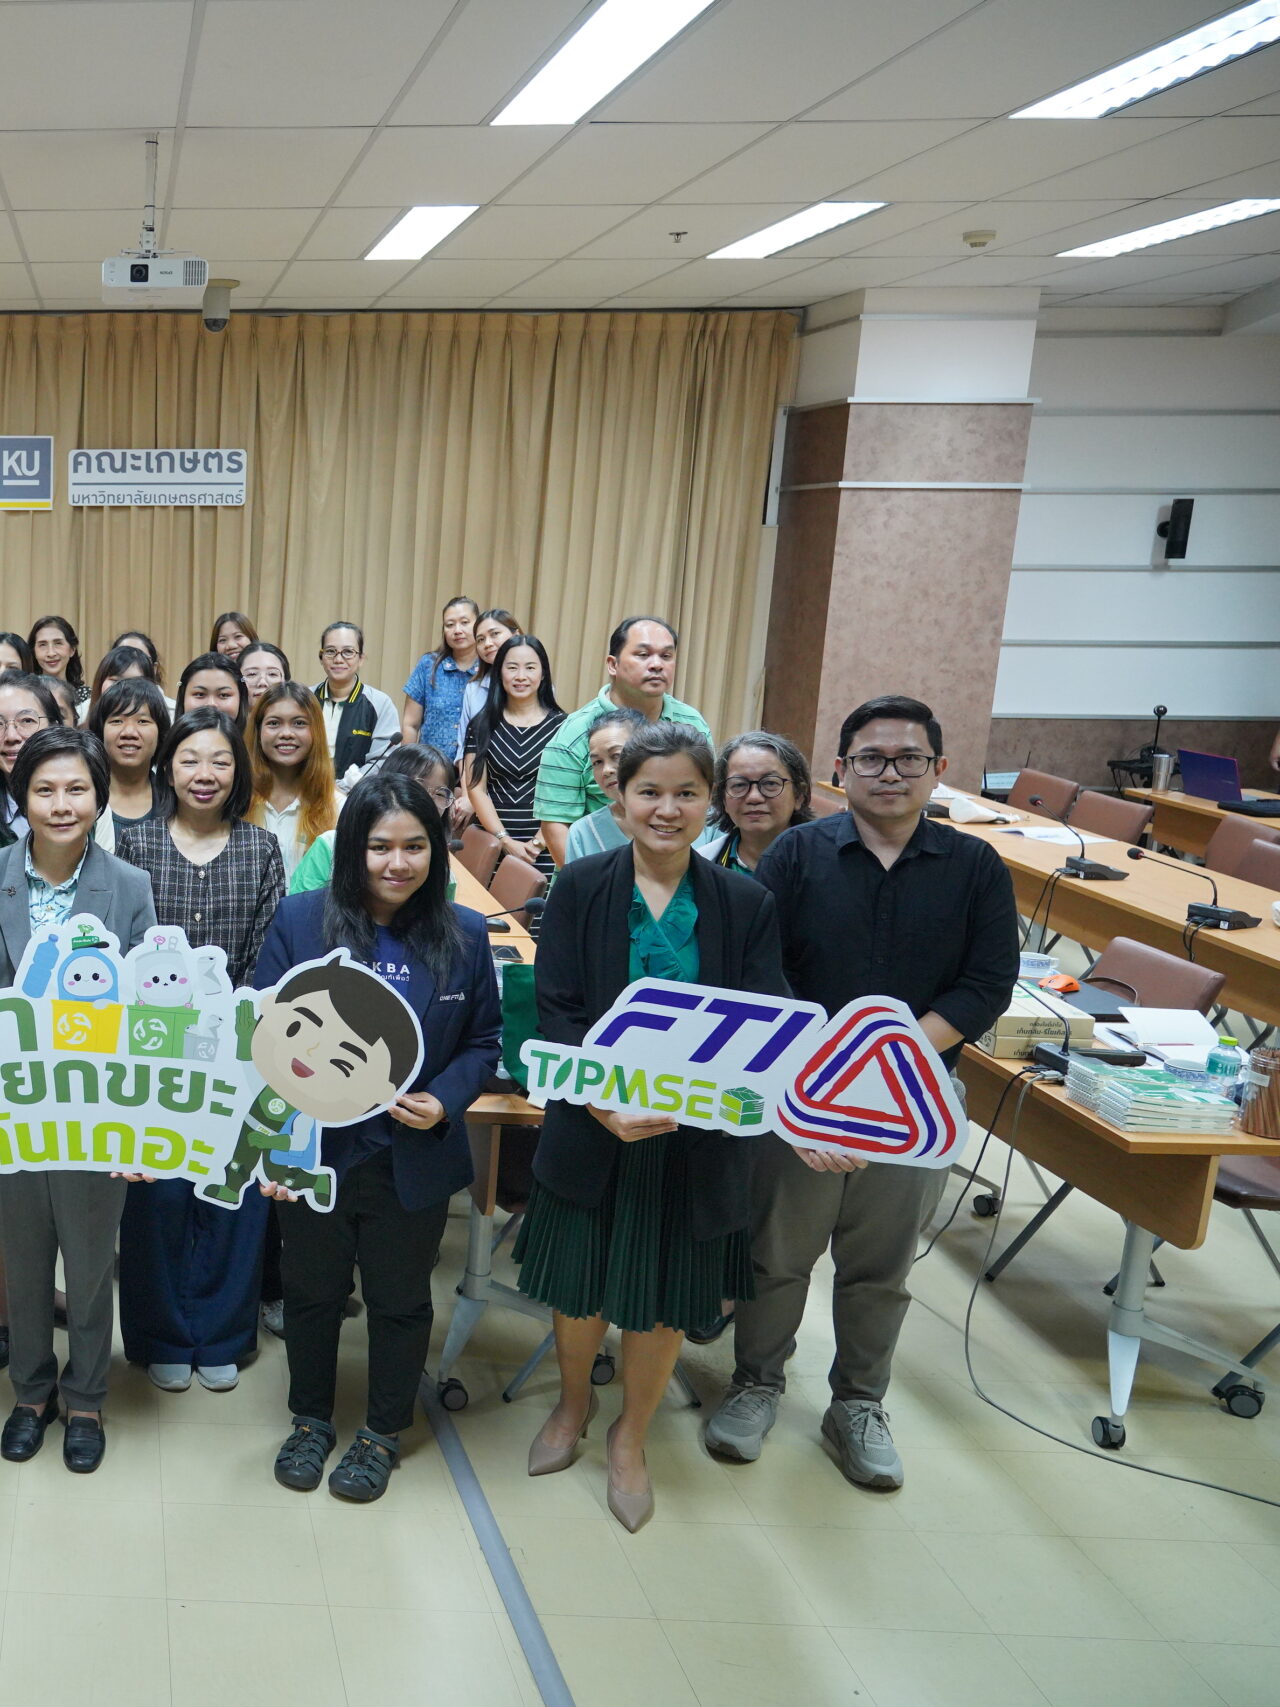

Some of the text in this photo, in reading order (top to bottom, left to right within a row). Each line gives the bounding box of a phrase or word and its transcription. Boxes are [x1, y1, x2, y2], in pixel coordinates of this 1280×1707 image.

[2, 450, 40, 477] KU
[72, 451, 244, 474] คณะเกษตร
[72, 489, 244, 505] มหาวิทยาลัยเกษตรศาสตร์
[594, 988, 817, 1073] FTI
